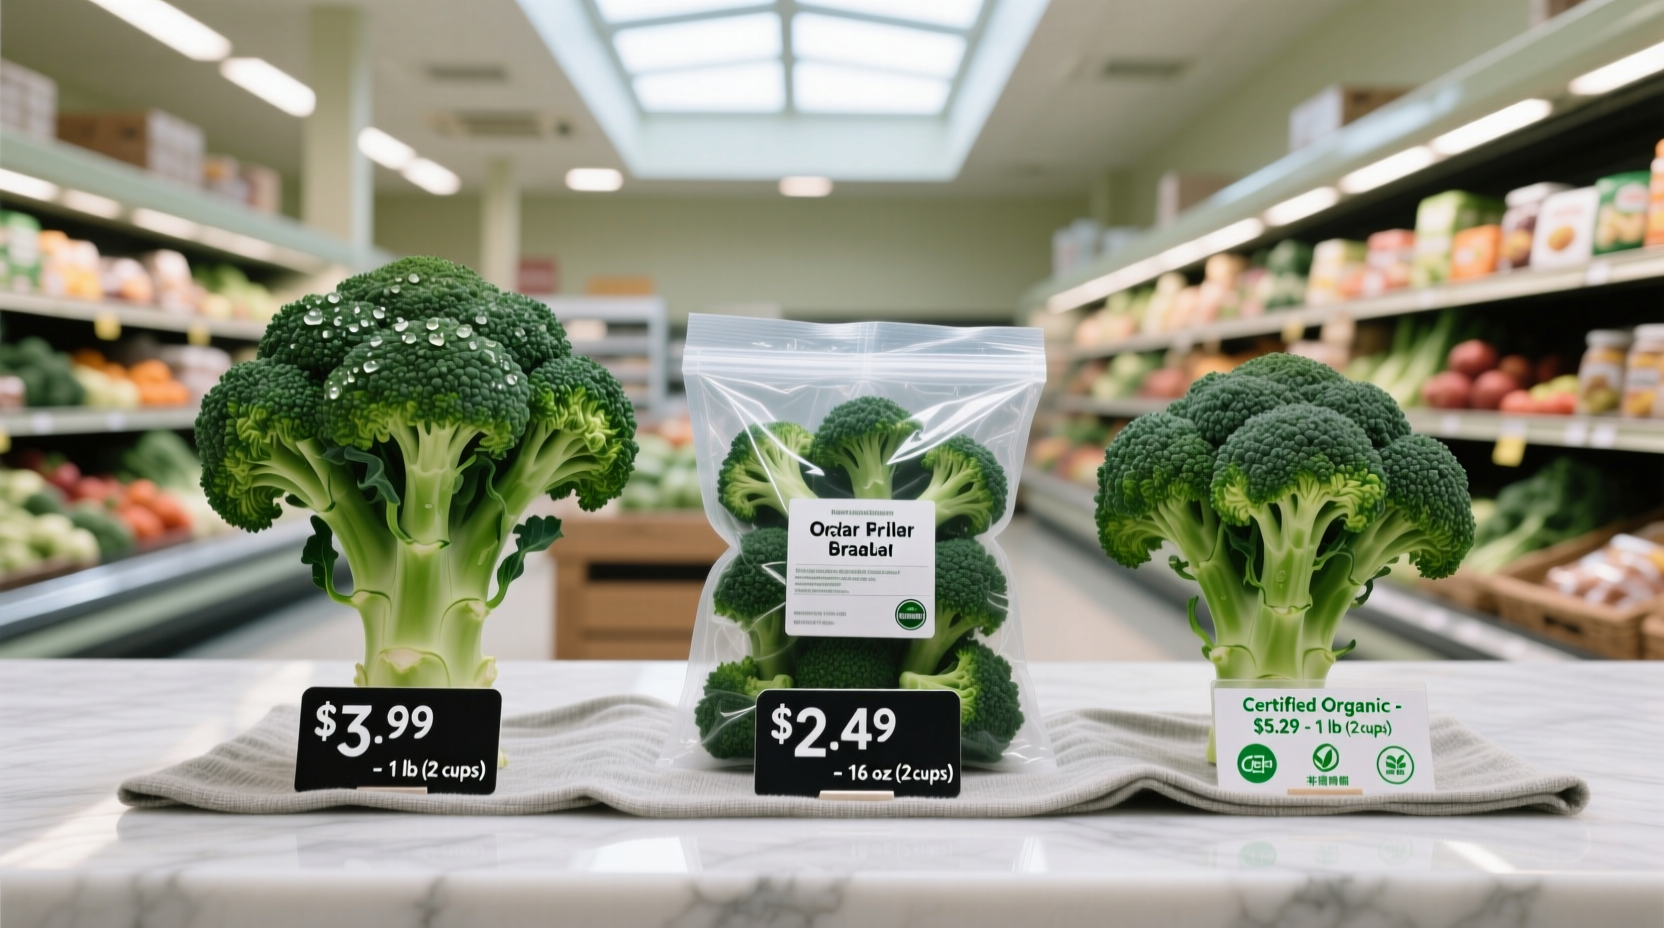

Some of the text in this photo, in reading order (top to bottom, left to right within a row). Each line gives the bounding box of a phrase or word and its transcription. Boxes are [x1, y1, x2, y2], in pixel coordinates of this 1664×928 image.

[1242, 696, 1316, 712] Certified
[1321, 697, 1391, 717] Organic
[314, 701, 434, 758] $3.99
[771, 703, 896, 758] $2.49
[1253, 718, 1300, 735] $5.29
[1315, 719, 1323, 734] 1
[1328, 719, 1342, 734] lb
[389, 760, 397, 777] 1
[402, 759, 418, 777] lb
[848, 764, 868, 781] 16
[872, 768, 892, 781] oz
